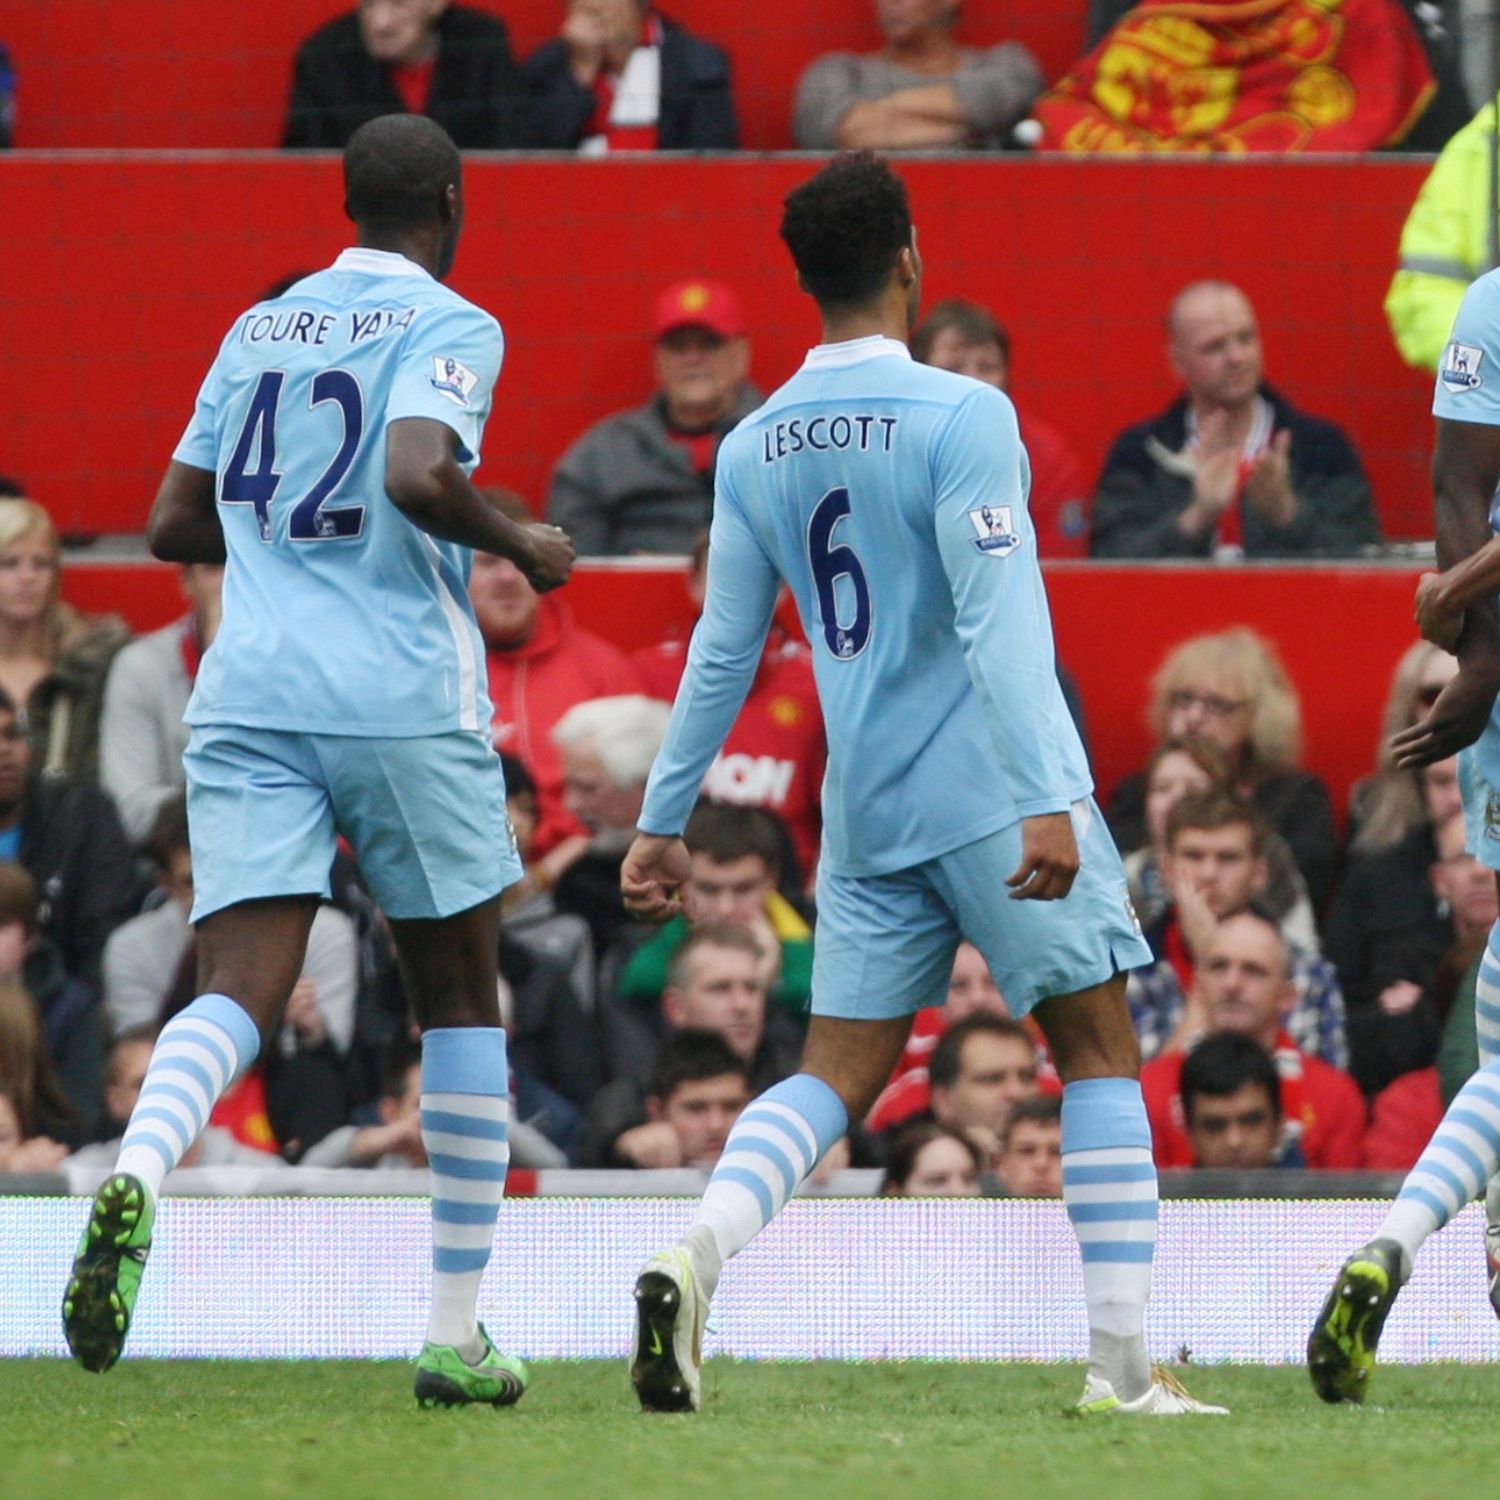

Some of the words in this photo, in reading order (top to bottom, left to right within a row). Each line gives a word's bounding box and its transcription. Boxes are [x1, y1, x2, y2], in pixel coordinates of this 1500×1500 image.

[239, 311, 337, 345] TOURE
[349, 308, 416, 344] YAYA
[218, 368, 366, 544] 42
[763, 414, 899, 464] LESCOTT
[807, 484, 873, 662] 6
